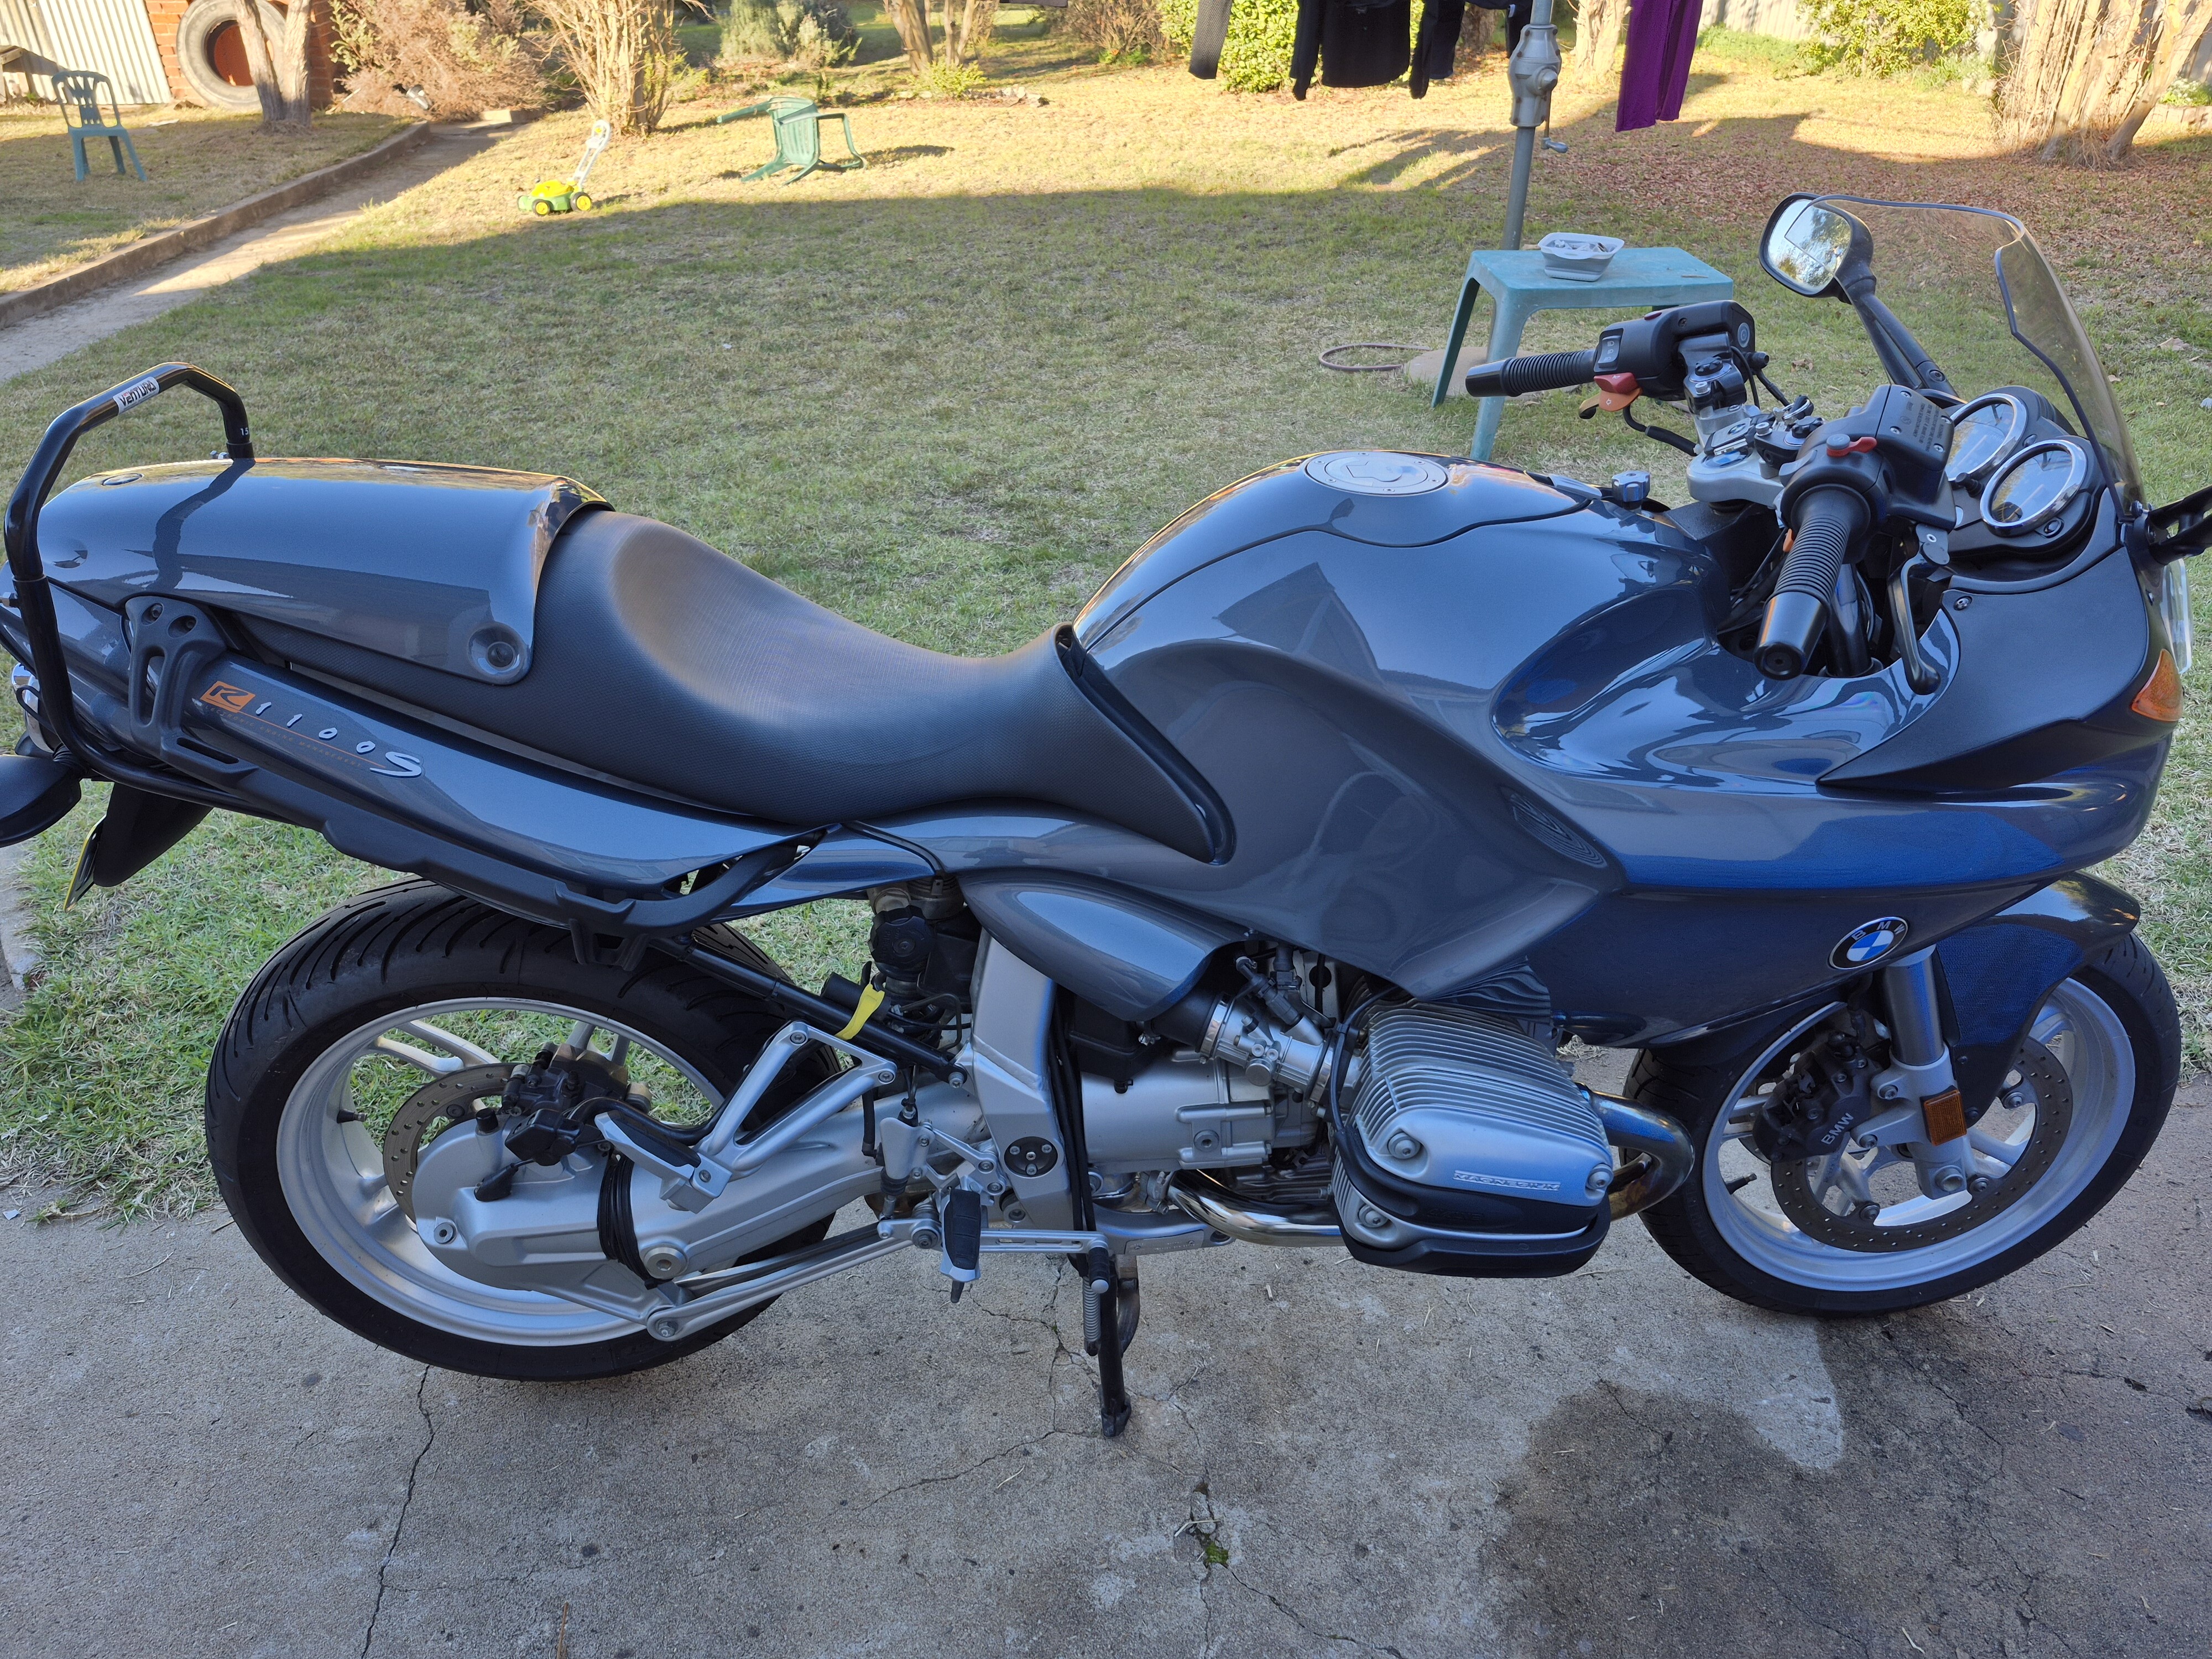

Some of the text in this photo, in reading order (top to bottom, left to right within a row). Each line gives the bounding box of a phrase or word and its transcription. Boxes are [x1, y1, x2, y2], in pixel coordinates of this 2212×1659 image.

[118, 380, 156, 406] VENTURA
[240, 427, 248, 436] 15
[198, 701, 254, 727] LECTRONIC
[1851, 920, 1906, 941] BMW
[1821, 1113, 1854, 1145] BMW
[1453, 1172, 1560, 1190] MAGNESIUM
